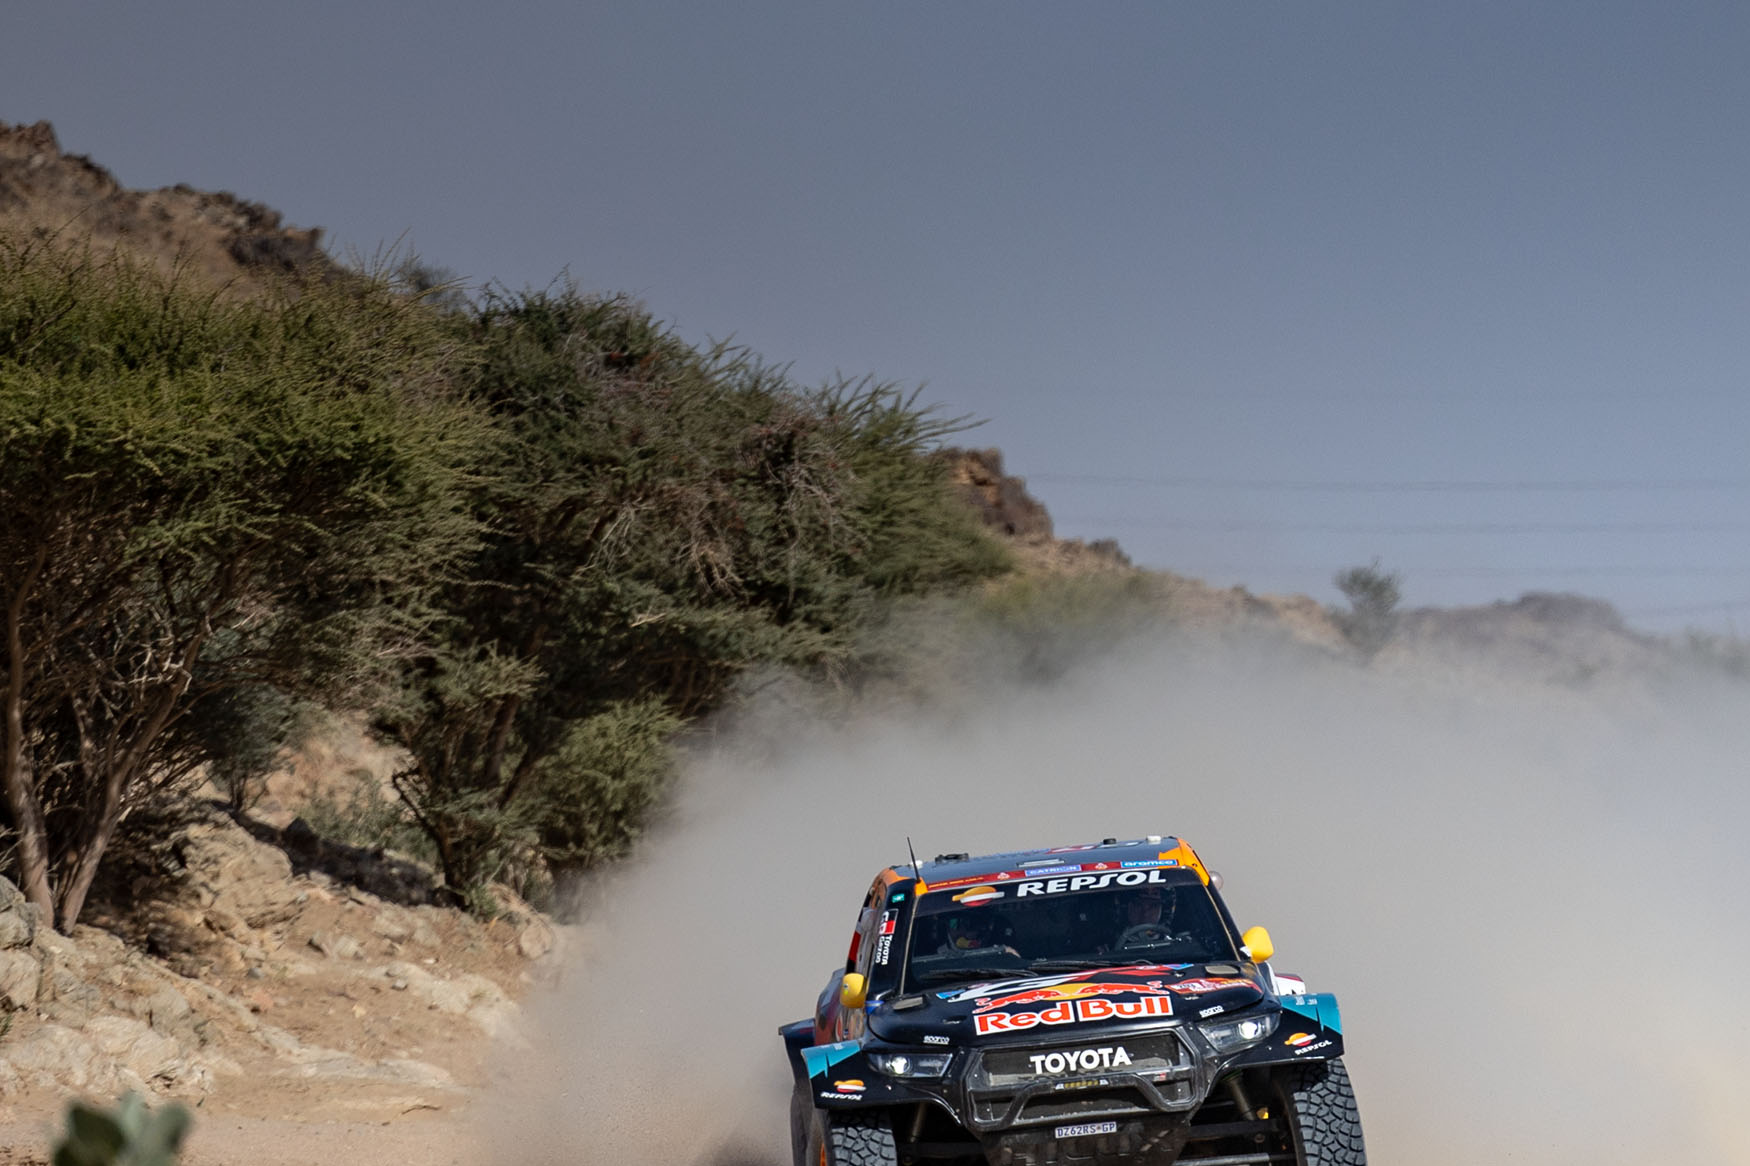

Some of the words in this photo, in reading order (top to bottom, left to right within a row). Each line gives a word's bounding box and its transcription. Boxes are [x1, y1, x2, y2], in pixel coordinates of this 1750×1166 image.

[1017, 870, 1166, 897] REPSOL
[881, 935, 893, 965] TOYOTA
[976, 1002, 1072, 1033] Red
[1079, 997, 1170, 1019] Bull
[1030, 1046, 1132, 1074] TOYOTA
[1294, 1040, 1333, 1055] REPSOL
[820, 1091, 863, 1101] REPSOL
